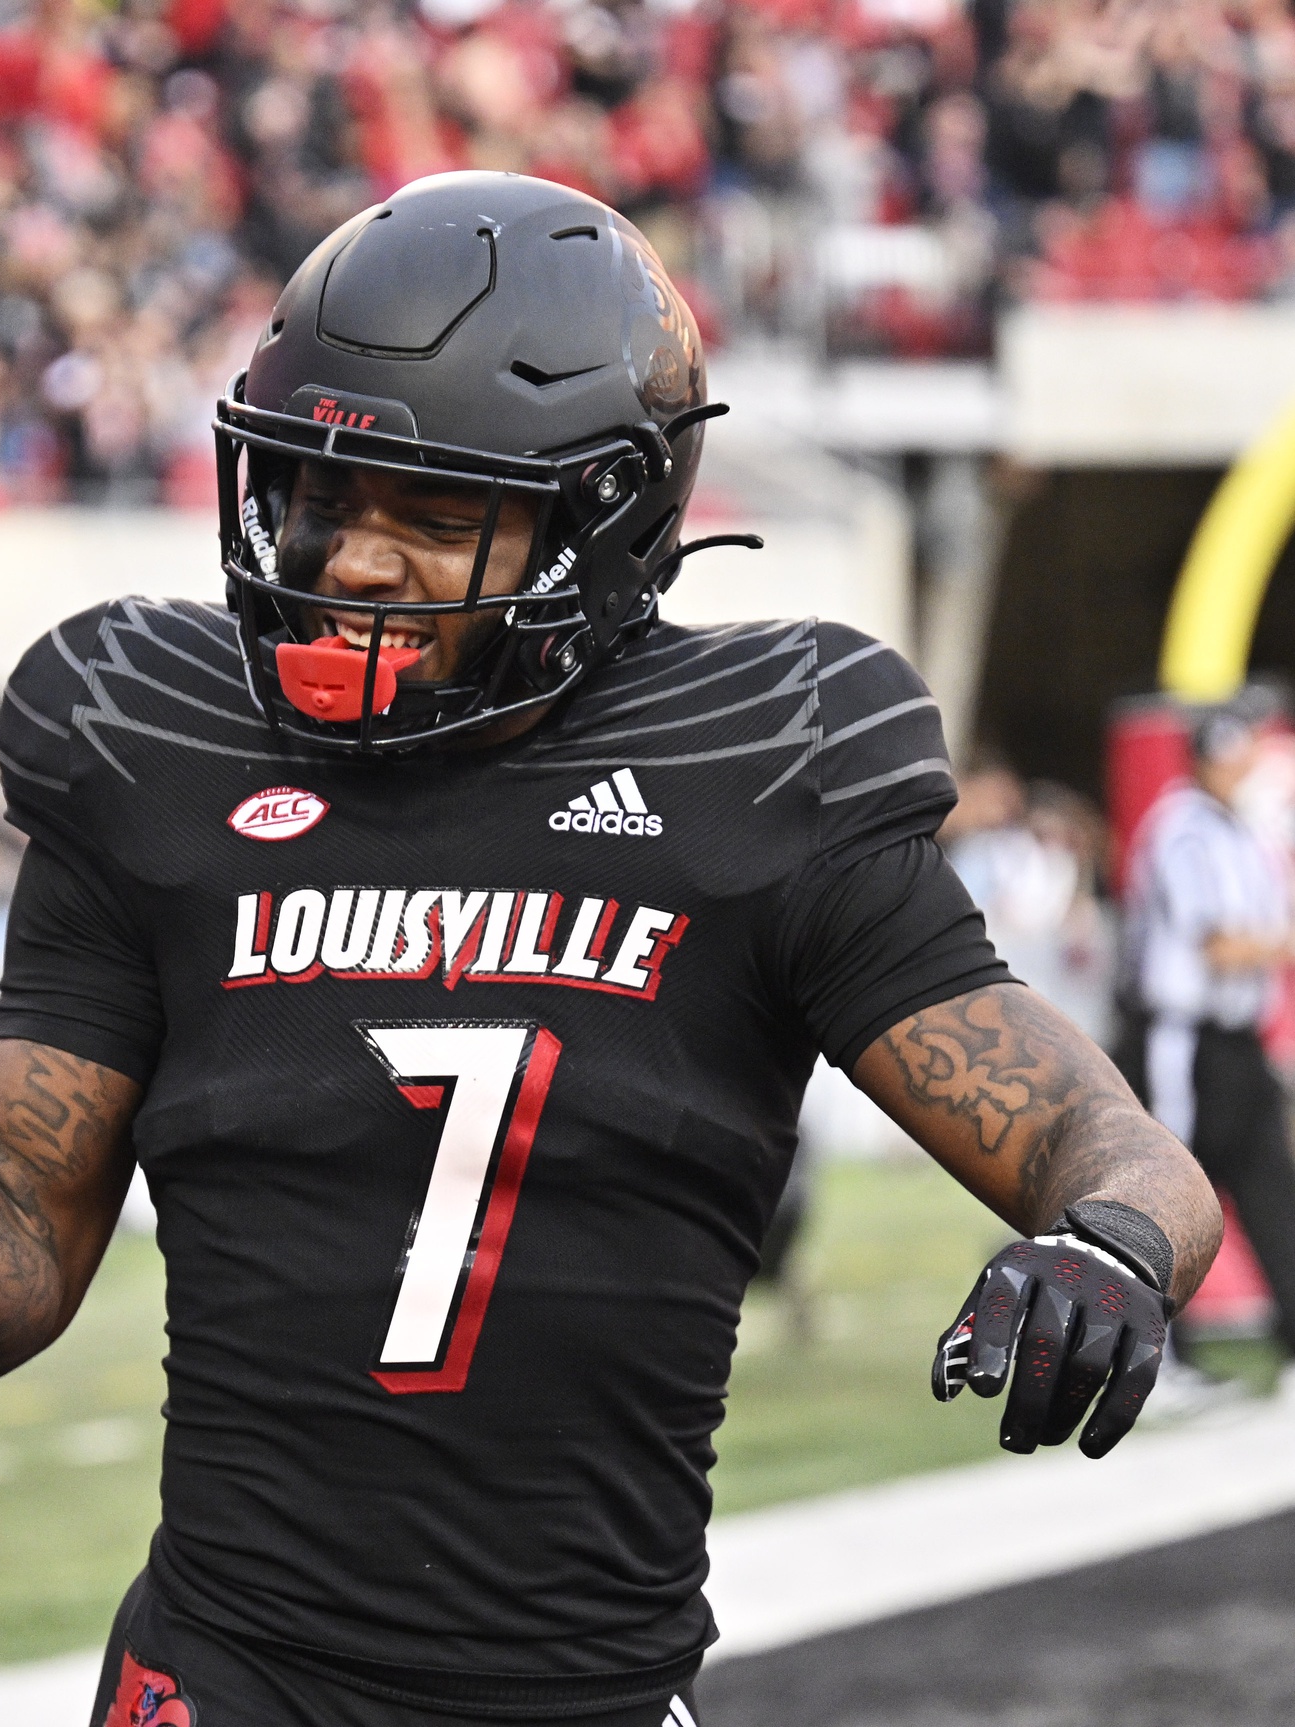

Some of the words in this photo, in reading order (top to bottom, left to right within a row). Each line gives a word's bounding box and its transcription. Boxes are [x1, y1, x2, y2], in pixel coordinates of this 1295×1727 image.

[319, 397, 338, 409] THE
[244, 797, 311, 824] ACC
[548, 809, 663, 836] adidas
[220, 888, 691, 1001] LOUISVILLE
[356, 1021, 562, 1393] 7
